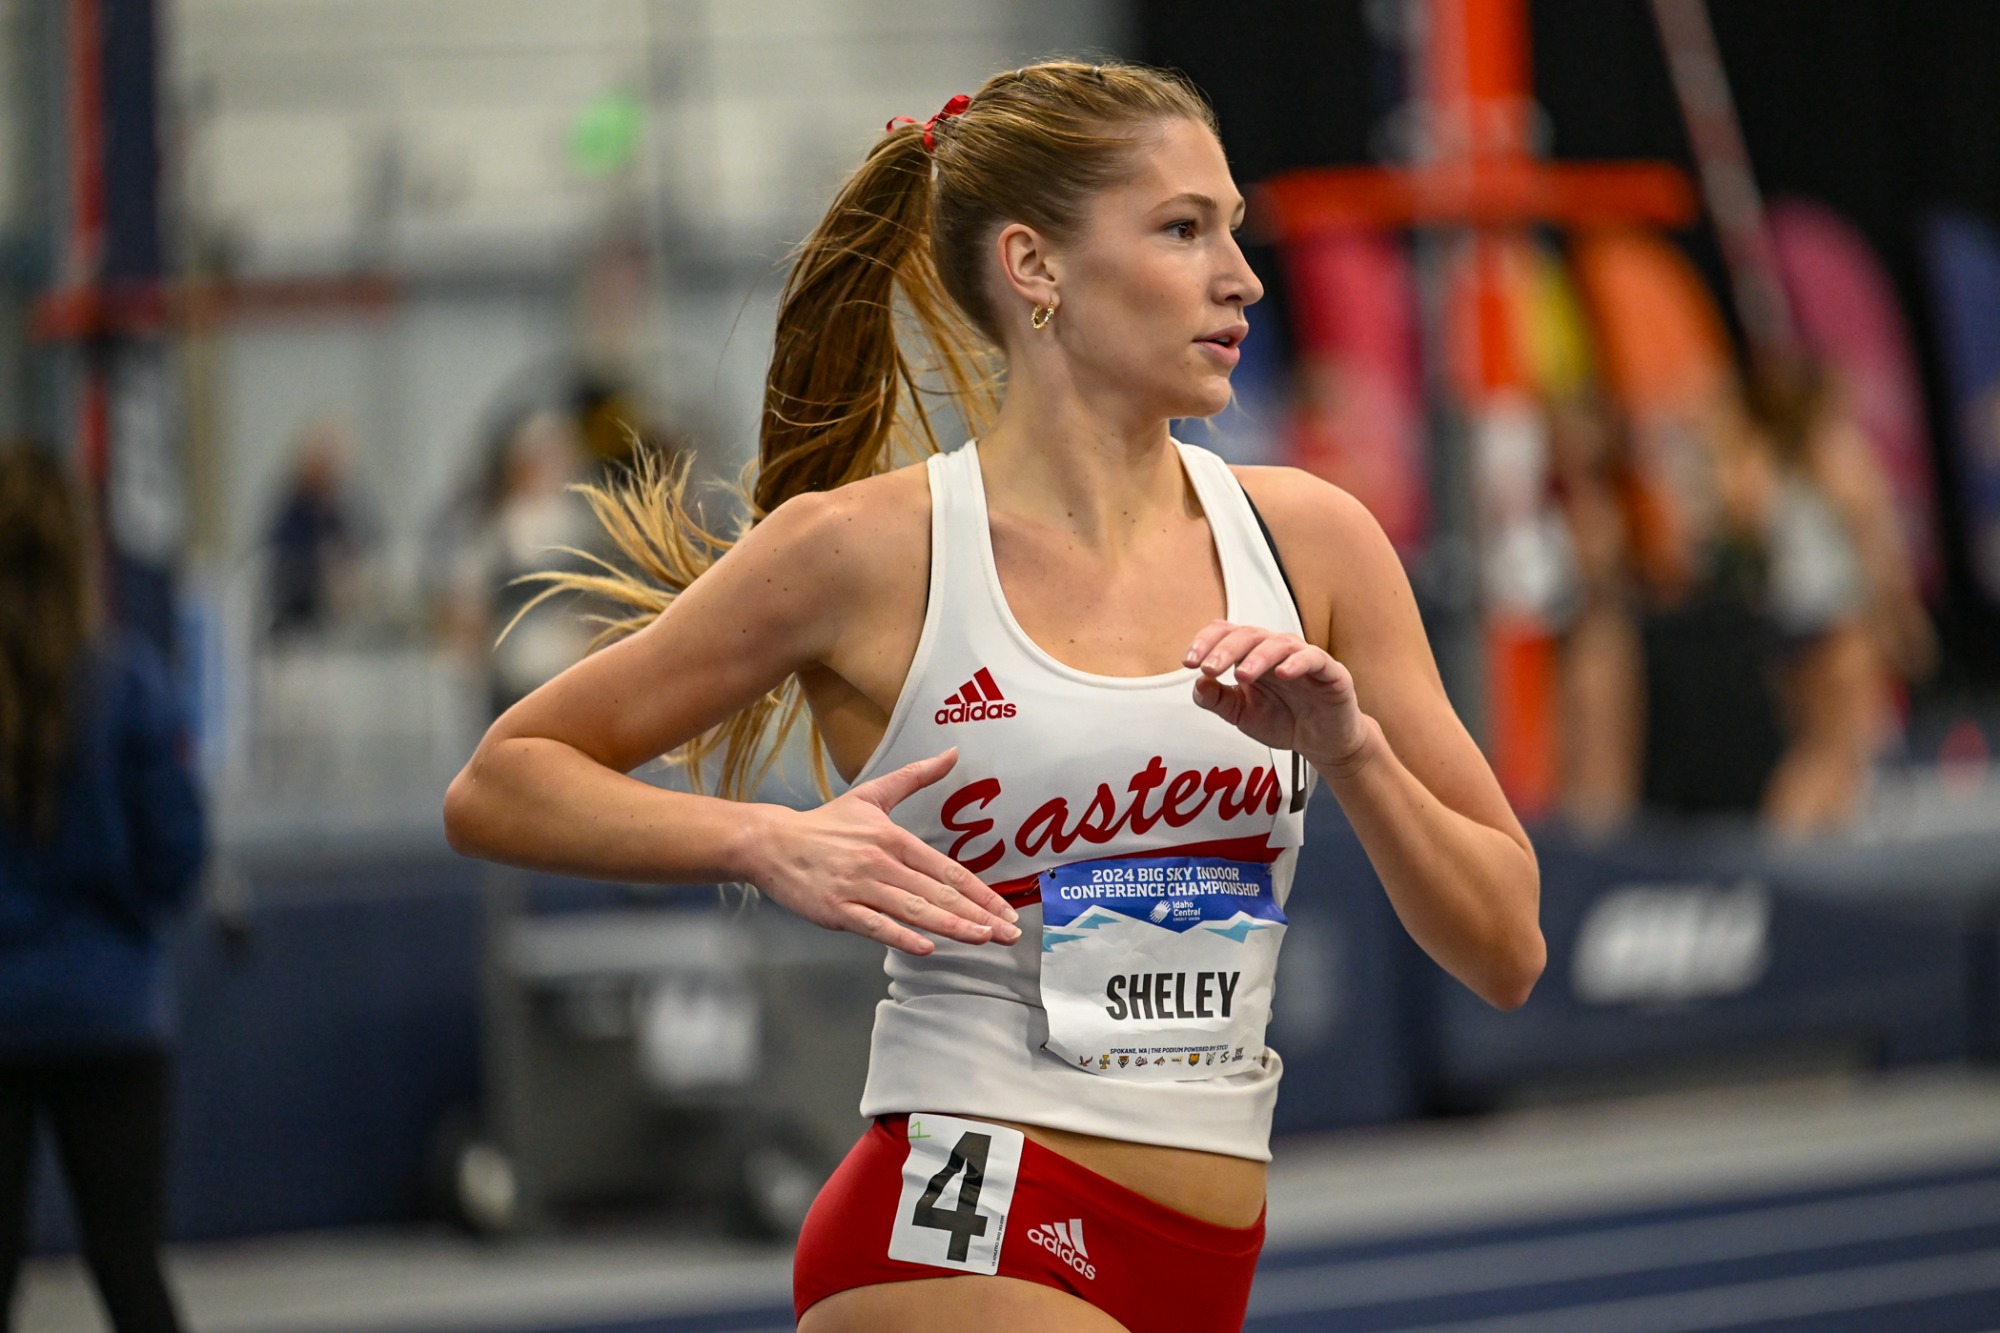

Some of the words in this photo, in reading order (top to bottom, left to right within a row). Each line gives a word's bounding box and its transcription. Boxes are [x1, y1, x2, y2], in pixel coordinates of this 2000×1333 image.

[935, 700, 1017, 725] adidas
[940, 756, 1282, 874] Eastern
[1092, 869, 1135, 883] 2024
[1137, 868, 1164, 882] BIG
[1167, 867, 1193, 881] SKY
[1196, 866, 1240, 881] INDOOR
[1060, 883, 1165, 900] CONFERENCE
[1167, 881, 1260, 897] CHAMPIONSHIP
[1172, 900, 1194, 909] Idaho
[1173, 907, 1200, 917] Central
[1105, 971, 1241, 1021] SHELEY
[907, 1121, 931, 1139] 1
[912, 1131, 992, 1263] 4
[1026, 1228, 1096, 1280] adidas
